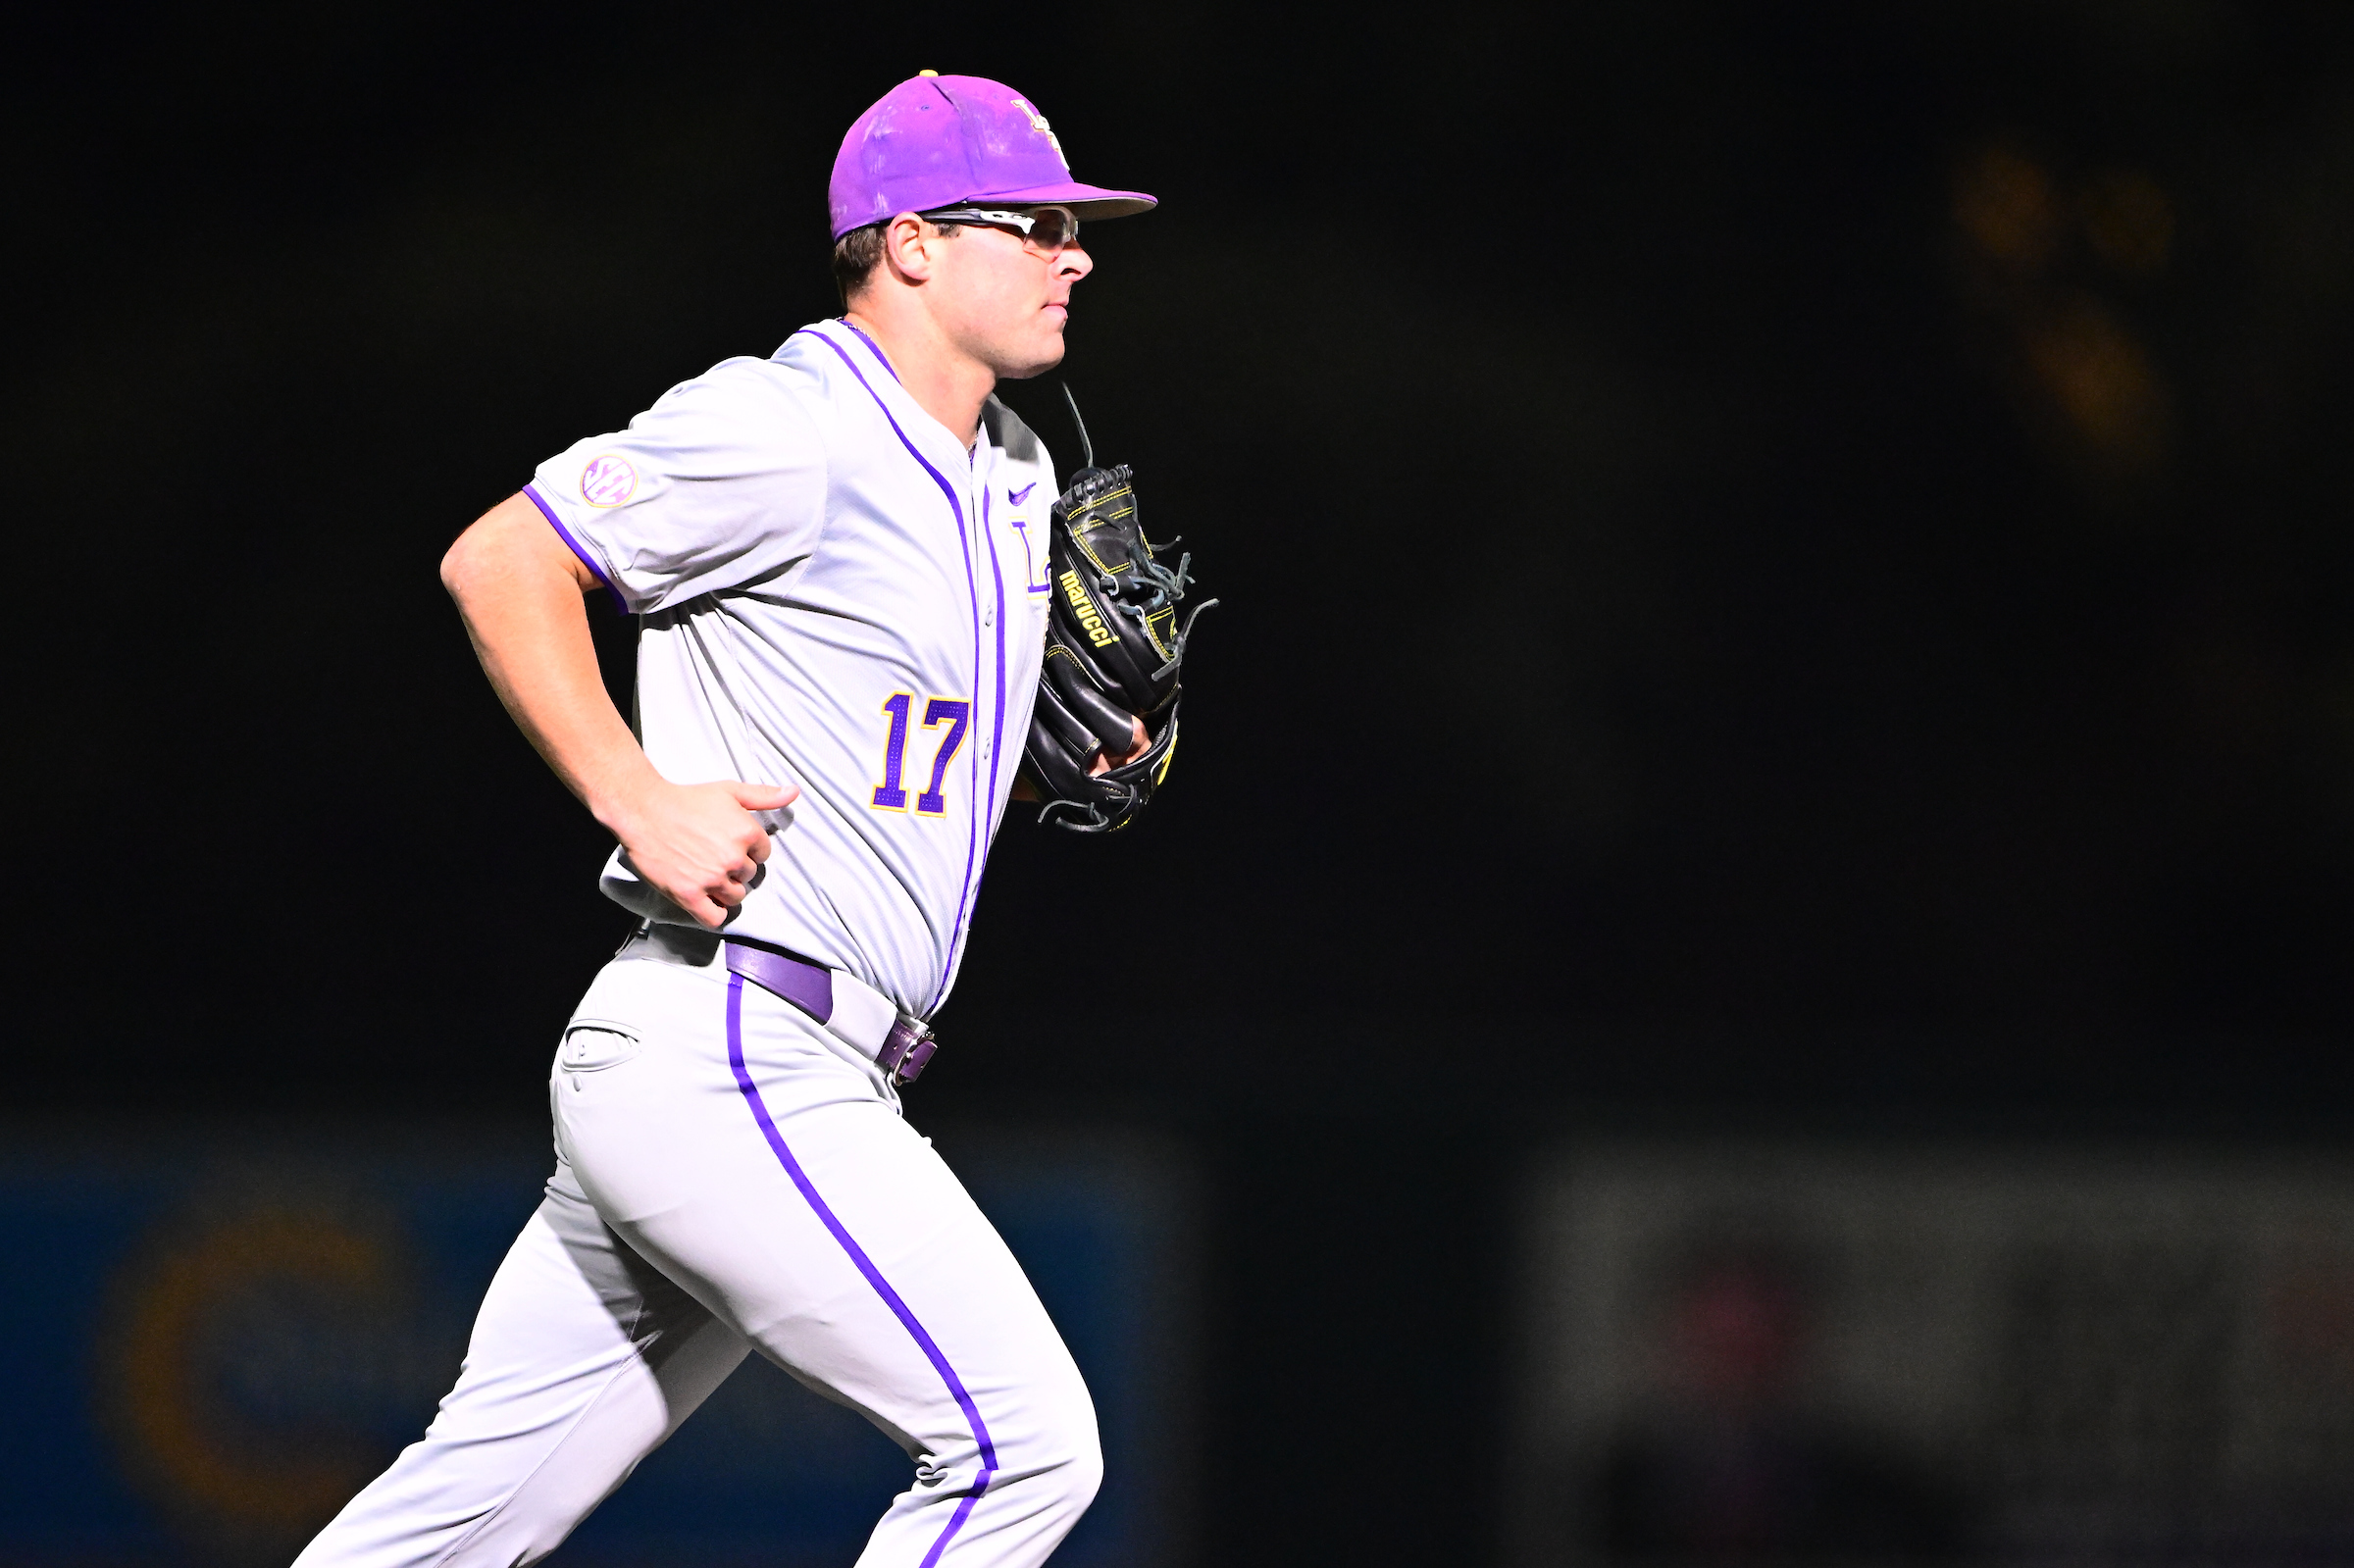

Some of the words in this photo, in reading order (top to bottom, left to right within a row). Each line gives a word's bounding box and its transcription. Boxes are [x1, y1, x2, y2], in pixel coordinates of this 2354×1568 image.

[584, 457, 636, 503] SEC
[1059, 570, 1119, 647] marucci
[870, 690, 971, 818] 17
